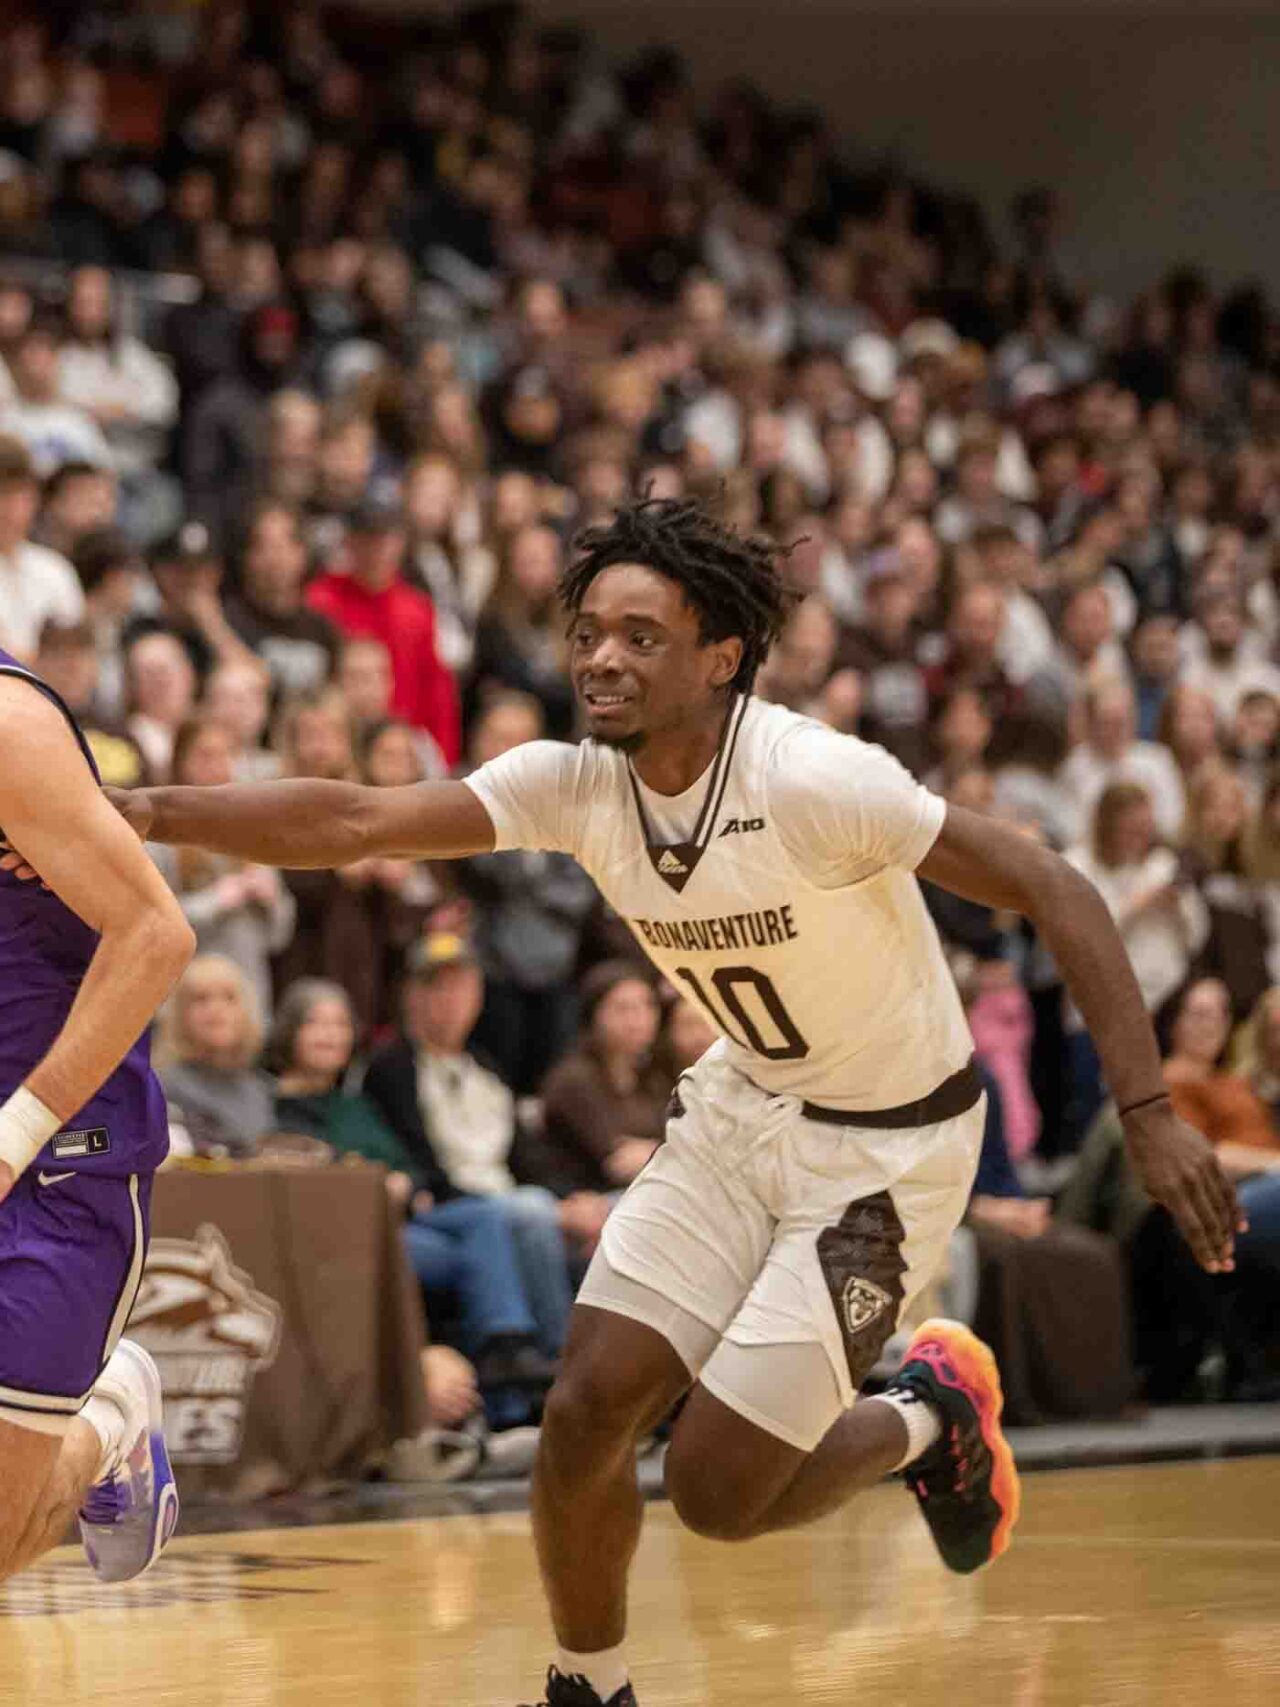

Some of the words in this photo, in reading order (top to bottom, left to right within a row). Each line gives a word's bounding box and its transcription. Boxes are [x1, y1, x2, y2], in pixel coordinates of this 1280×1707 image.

[634, 904, 798, 950] BONAVENTURE
[675, 966, 810, 1060] 10
[93, 1135, 102, 1147] L
